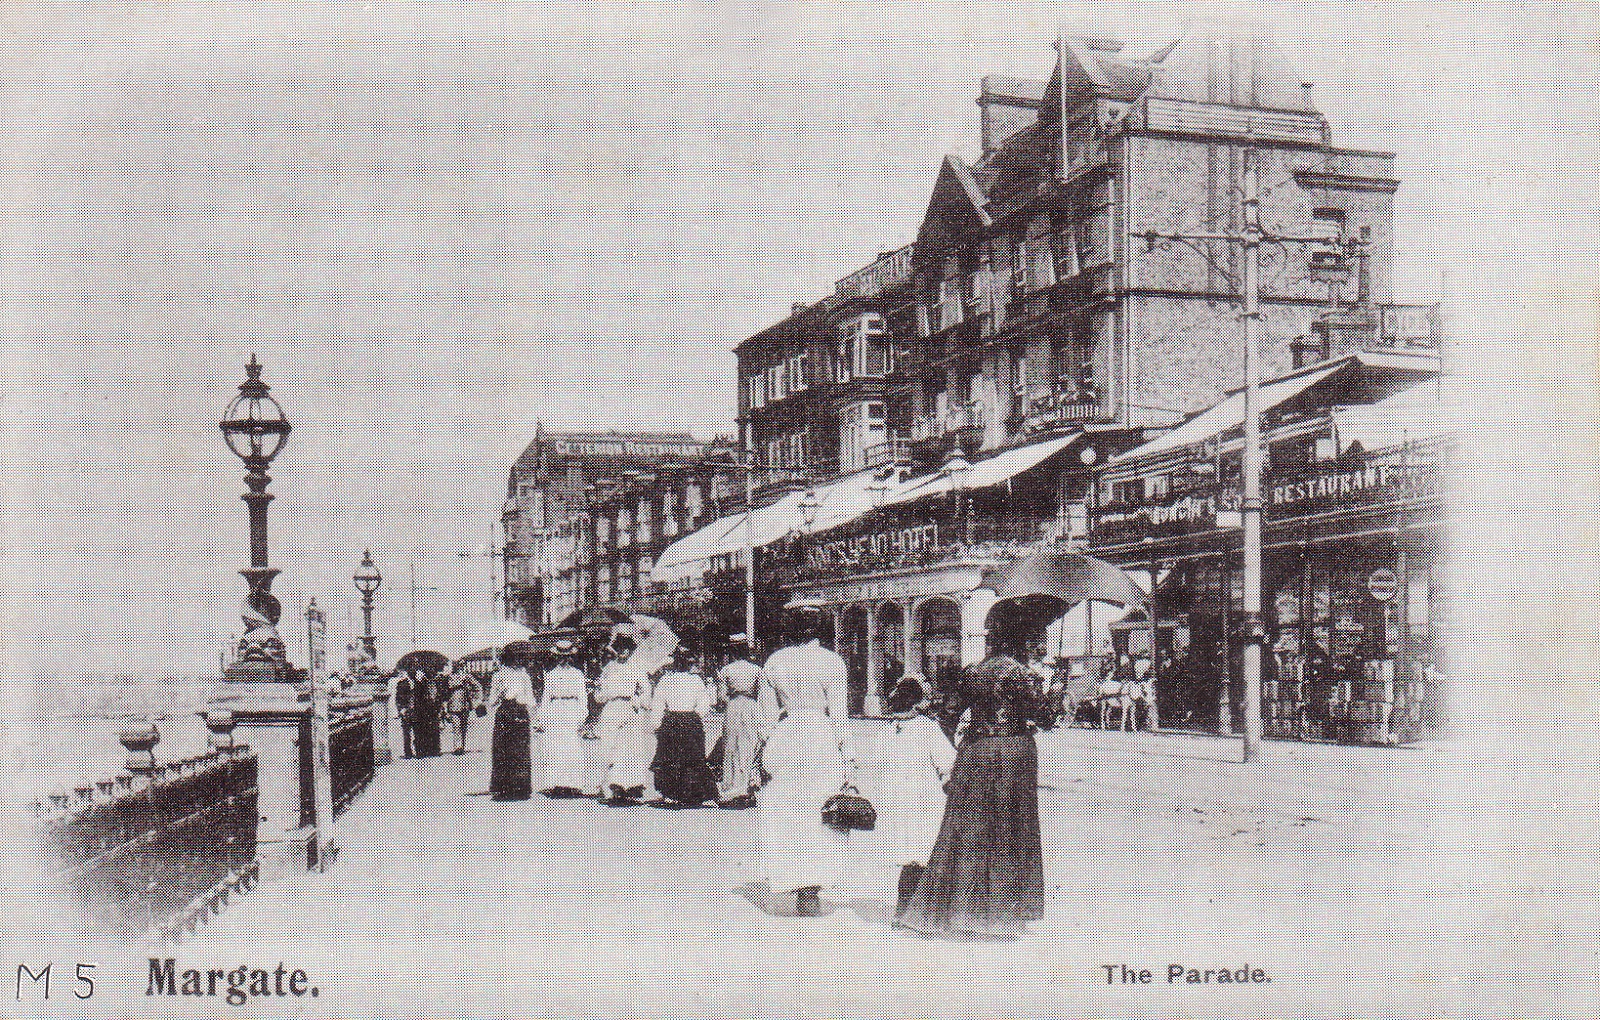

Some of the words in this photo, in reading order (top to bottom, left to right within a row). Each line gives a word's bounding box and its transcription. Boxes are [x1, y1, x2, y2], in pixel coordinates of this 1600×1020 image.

[1273, 465, 1390, 504] RESTAURANT
[890, 523, 939, 555] HOTEL
[17, 964, 51, 1000] M
[75, 963, 95, 1000] 5
